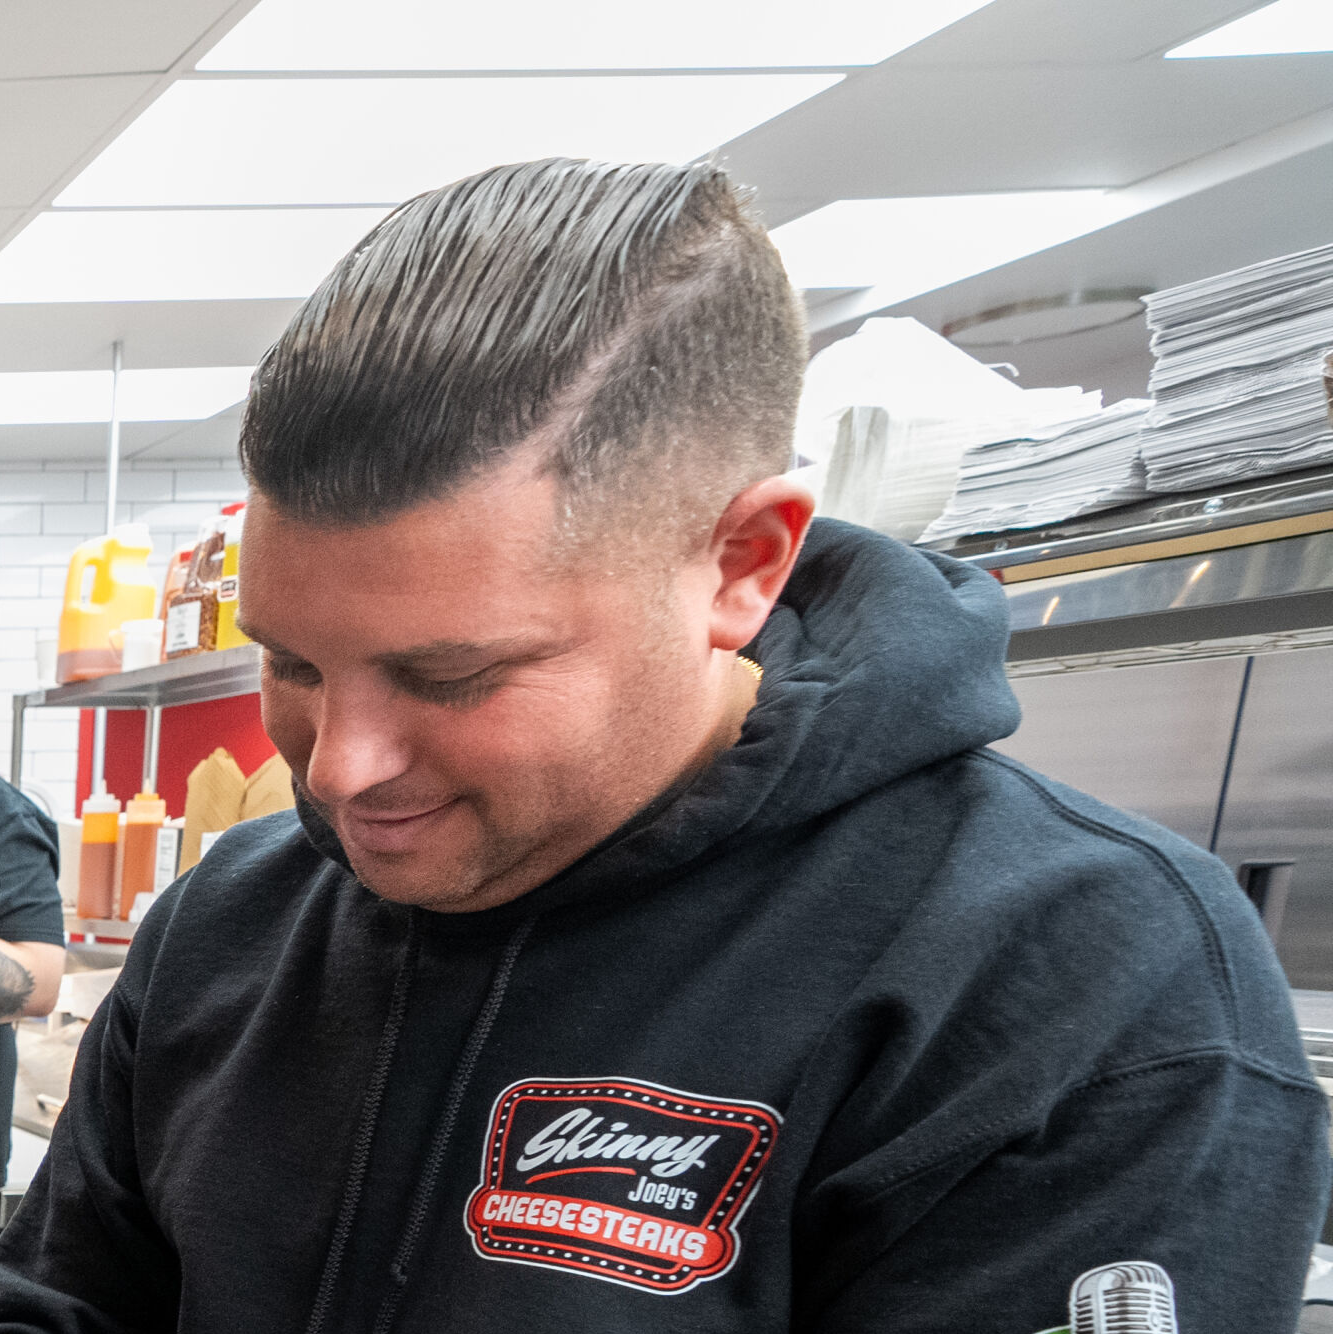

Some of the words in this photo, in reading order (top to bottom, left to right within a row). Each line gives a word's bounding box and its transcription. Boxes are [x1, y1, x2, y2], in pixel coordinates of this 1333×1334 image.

[516, 1107, 721, 1178] Skinny
[627, 1176, 698, 1210] Joey's
[483, 1194, 708, 1261] CHEESESTEAKS
